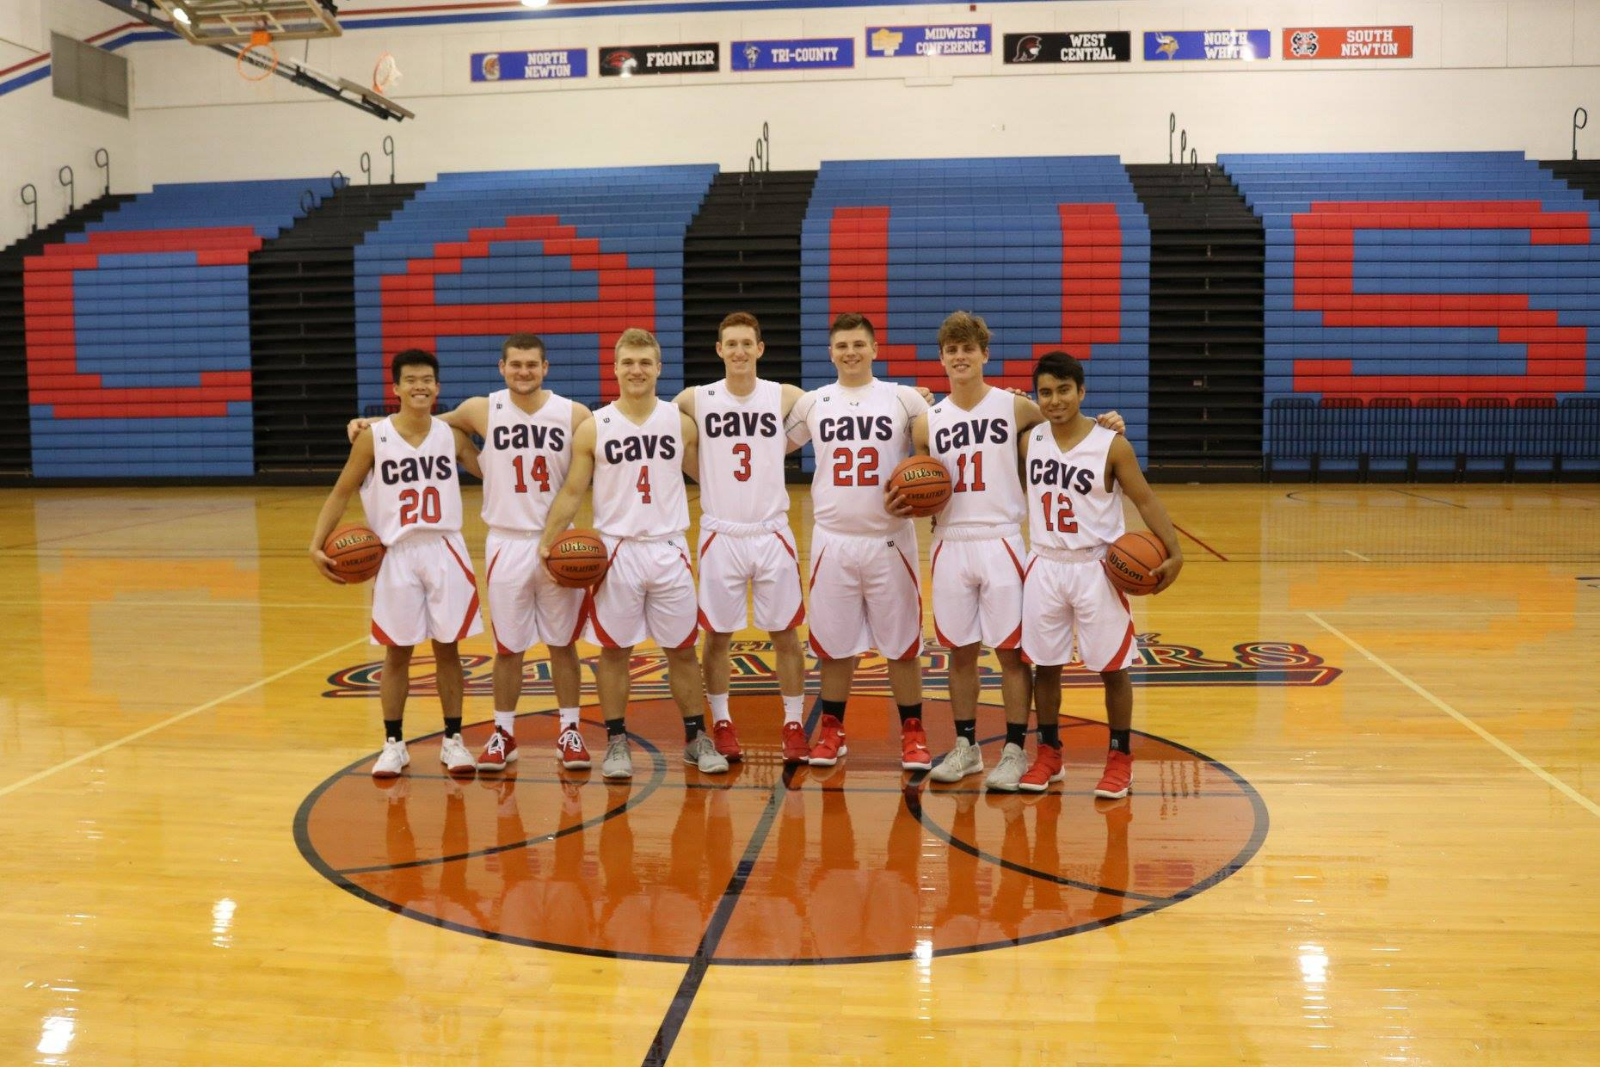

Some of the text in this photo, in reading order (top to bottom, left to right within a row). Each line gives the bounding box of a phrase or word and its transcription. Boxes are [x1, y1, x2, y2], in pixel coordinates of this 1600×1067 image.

[925, 28, 977, 40] MIDWEST
[1069, 34, 1106, 48] WEST
[1204, 32, 1248, 46] NORTH
[1346, 29, 1393, 43] SOUTH
[771, 47, 839, 63] TRI-COUNTY
[916, 41, 986, 54] CONFERENCE
[1060, 48, 1116, 62] CENTRAL
[1341, 43, 1398, 56] NEWTON
[527, 52, 568, 65] NORTH
[646, 50, 715, 67] FRONTIER
[524, 64, 571, 79] NEWTON
[732, 443, 752, 482] 3
[833, 447, 879, 487] 22
[512, 455, 551, 493] 14
[904, 467, 945, 482] Wilson
[954, 451, 986, 493] 11
[636, 465, 652, 504] 4
[398, 486, 443, 527] 20
[1041, 491, 1079, 534] 12
[334, 534, 376, 550] Wilson
[560, 541, 600, 554] Wilson
[1109, 551, 1144, 582] Wilson
